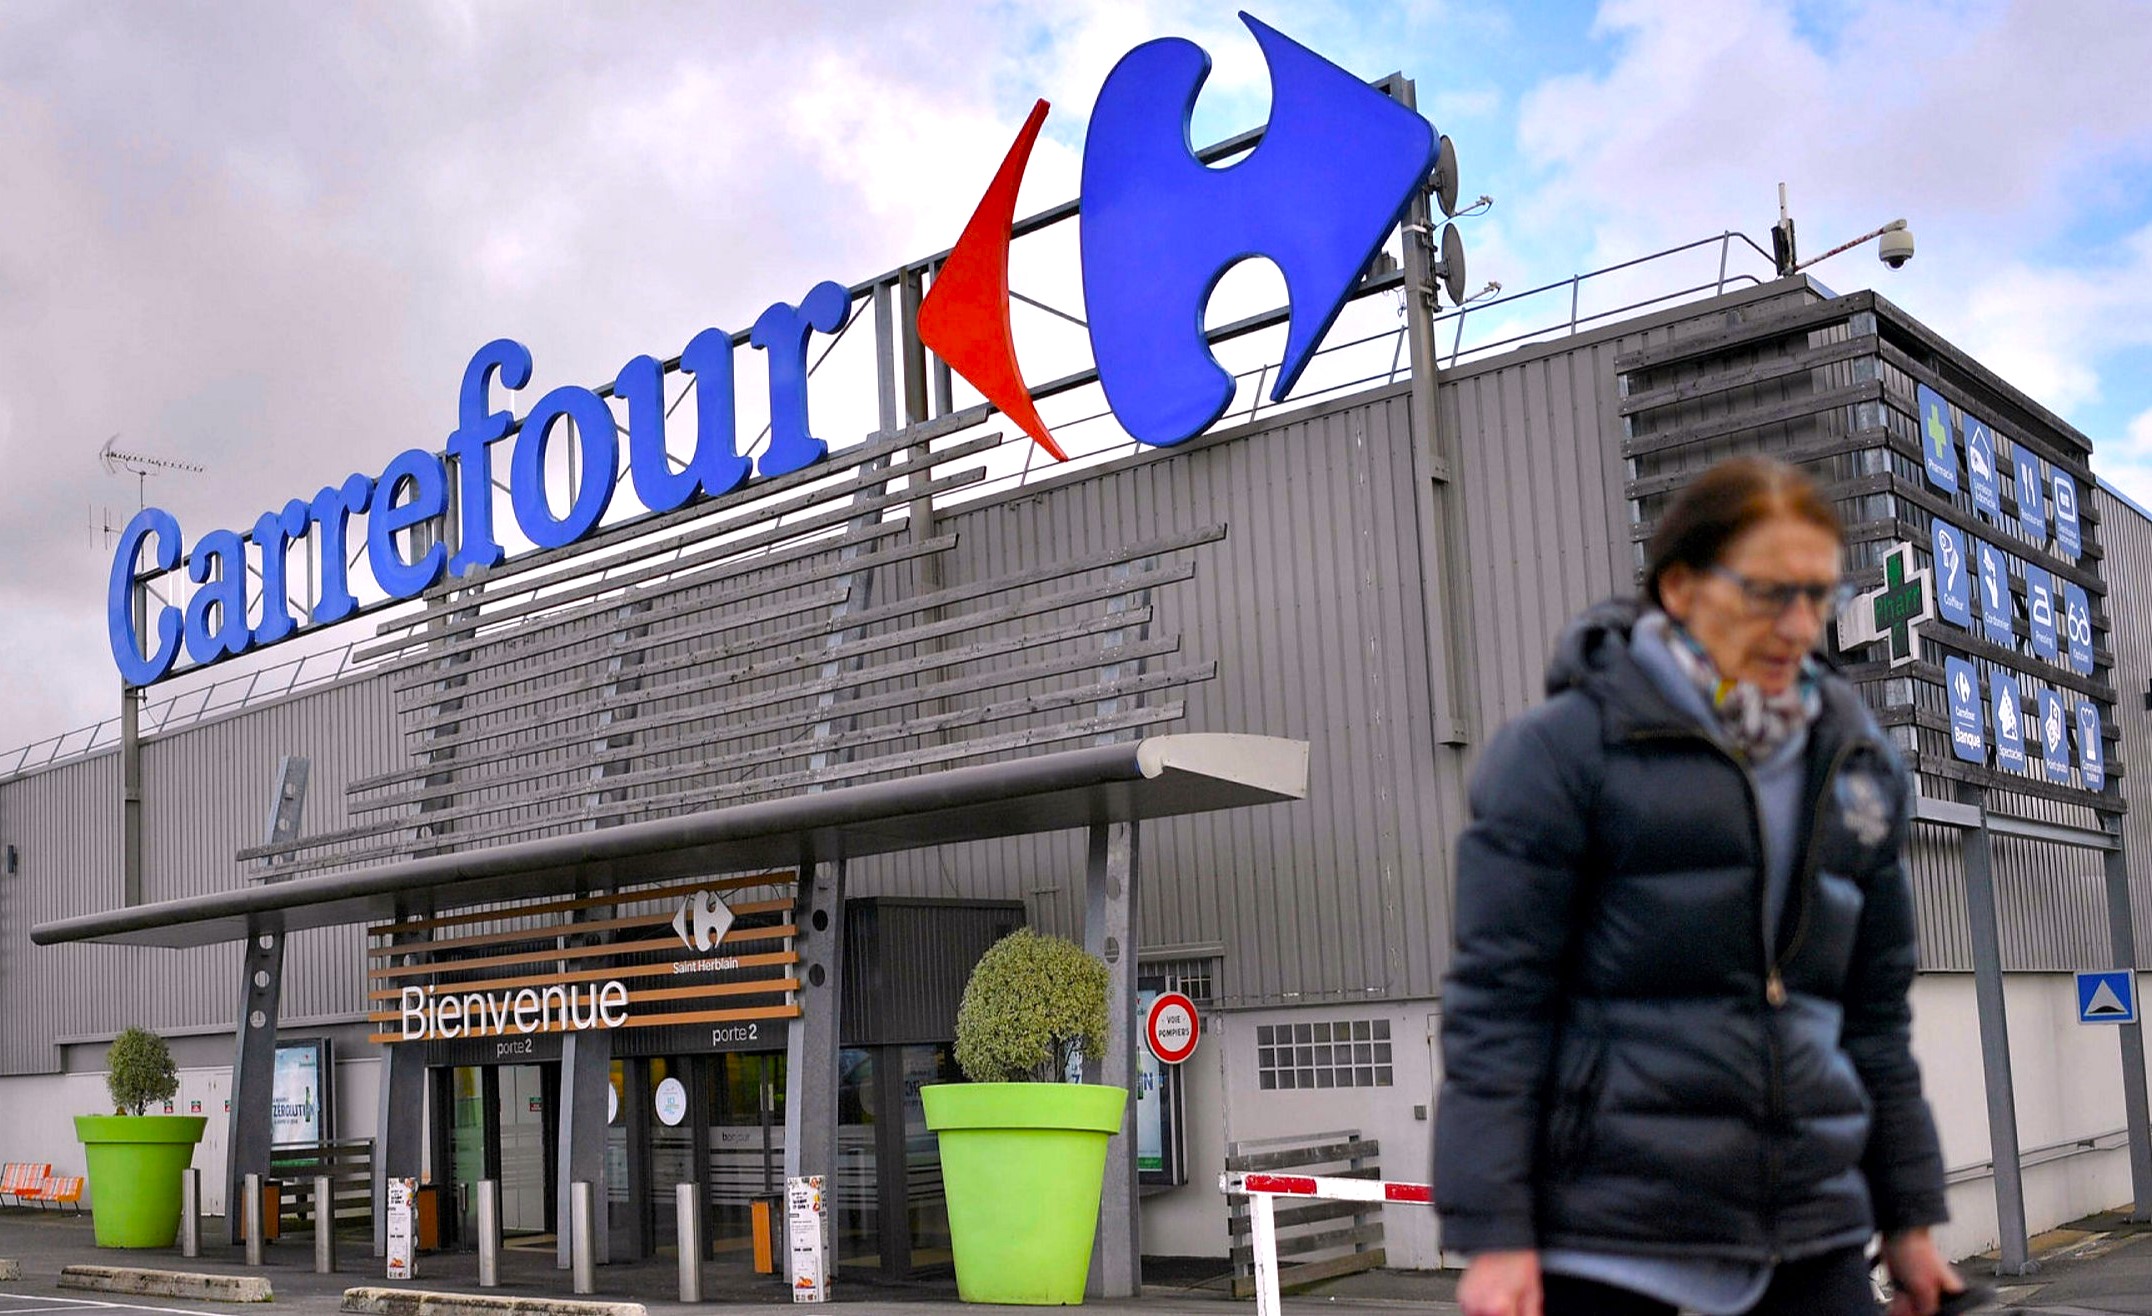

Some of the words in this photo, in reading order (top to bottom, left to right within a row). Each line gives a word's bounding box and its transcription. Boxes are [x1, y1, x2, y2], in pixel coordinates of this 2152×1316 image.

[108, 280, 852, 686] Carrefour
[1954, 726, 1981, 750] Banque
[673, 961, 697, 974] Saint
[698, 957, 739, 971] Herblain
[401, 980, 629, 1040] Bienvenue
[1166, 1015, 1181, 1024] VOIE
[1158, 1027, 1190, 1038] POMPIERS
